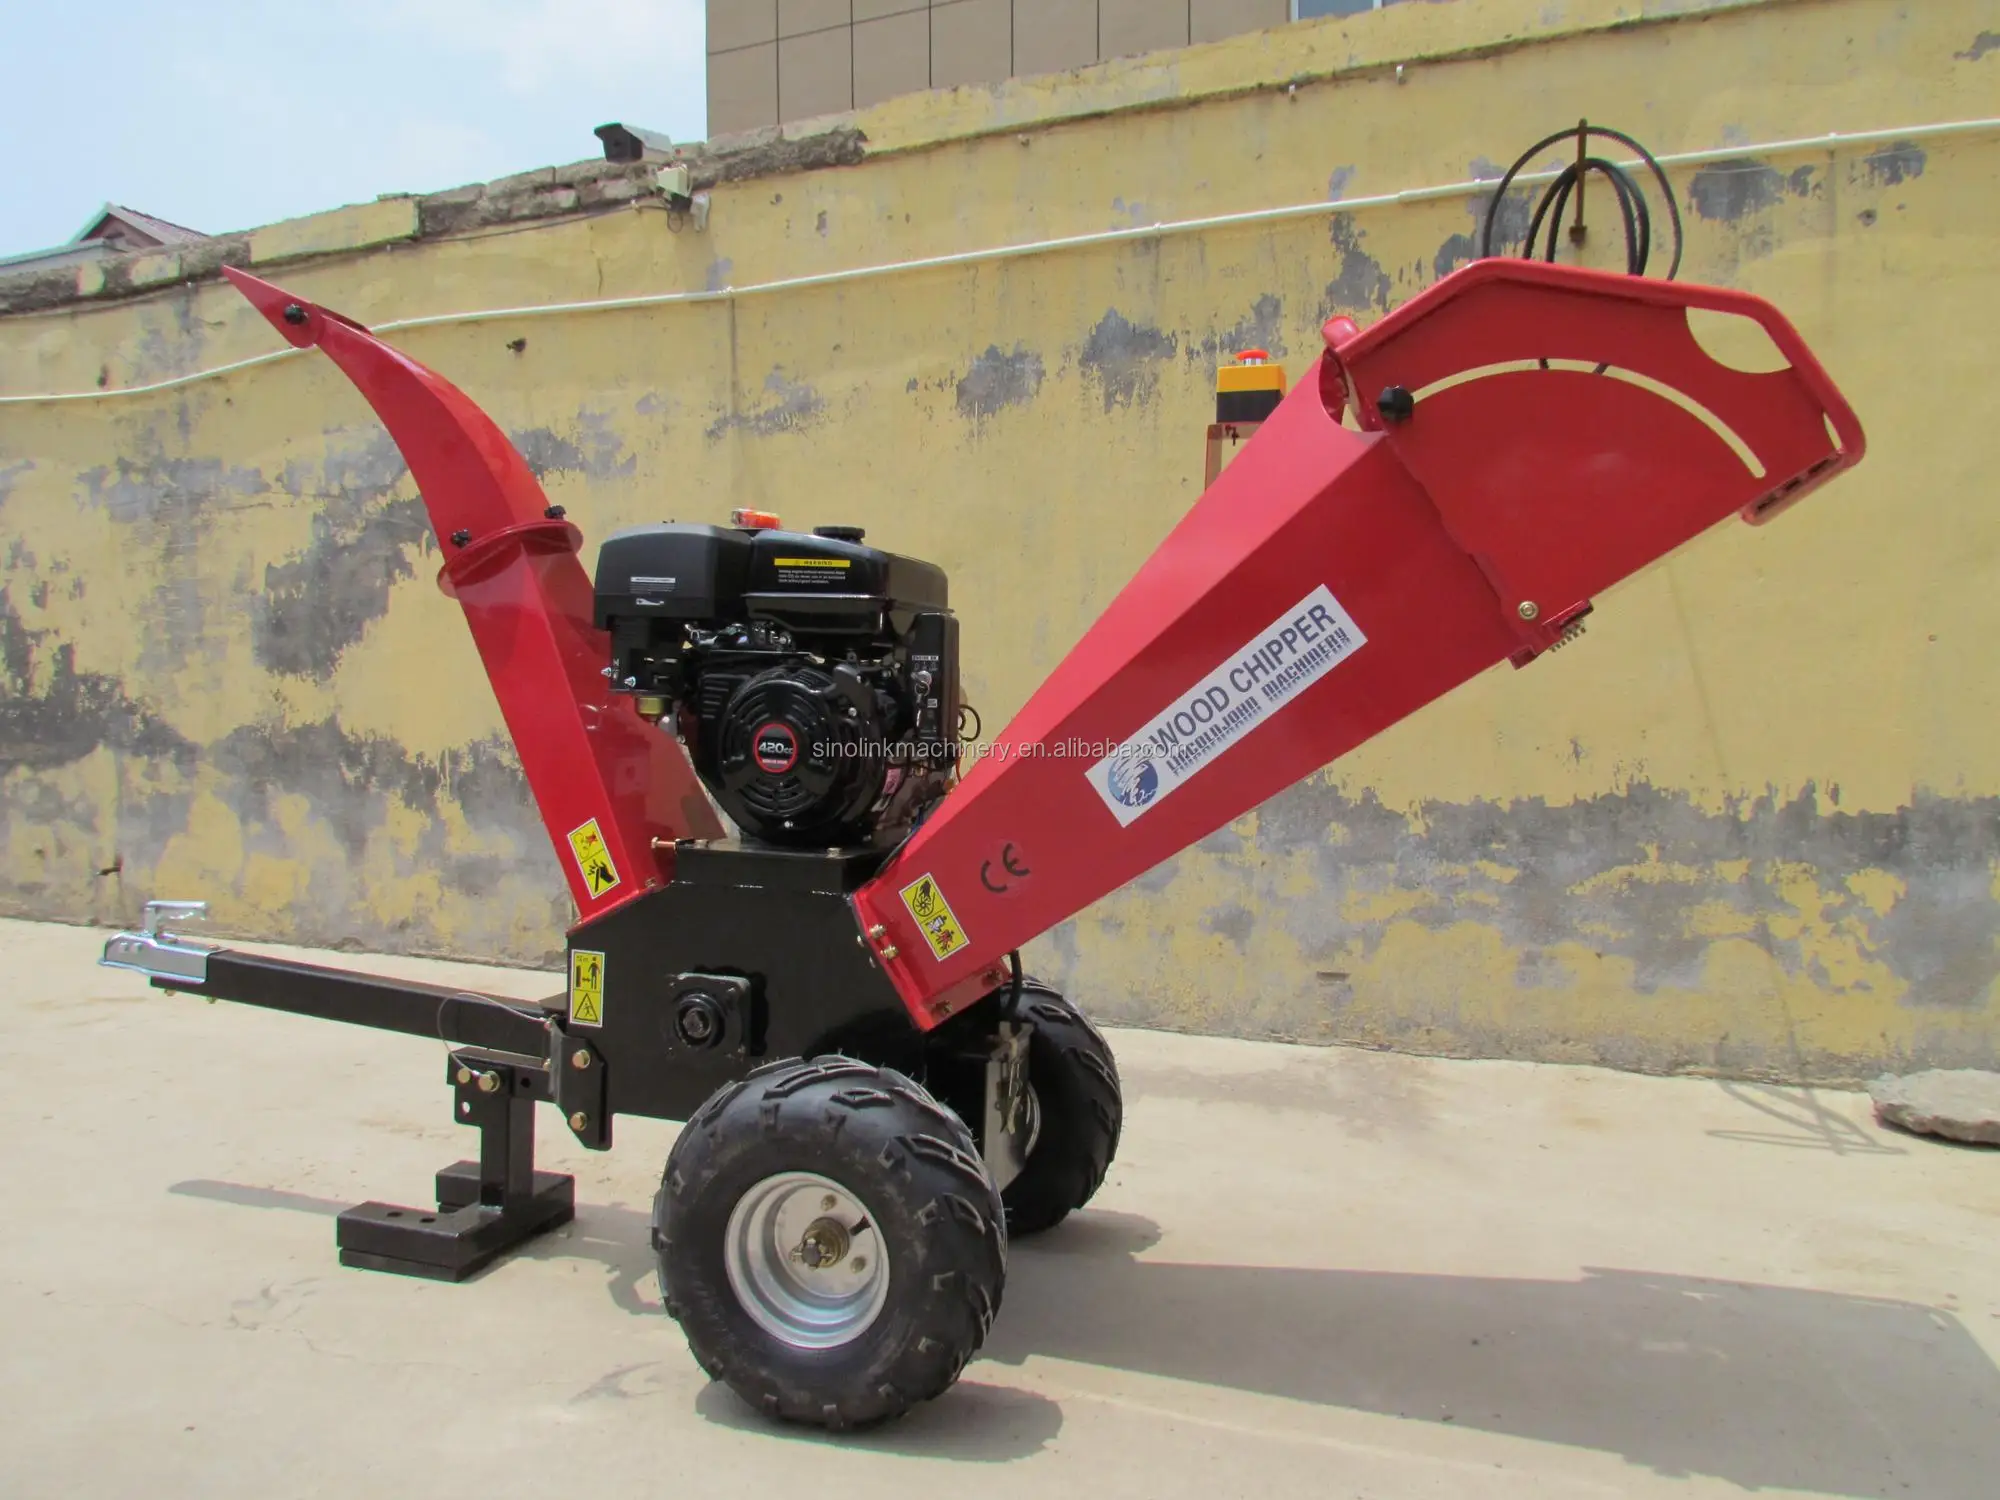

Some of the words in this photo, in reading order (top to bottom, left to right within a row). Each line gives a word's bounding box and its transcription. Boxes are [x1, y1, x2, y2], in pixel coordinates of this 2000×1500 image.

[1149, 685, 1230, 755] WOOD
[1229, 603, 1337, 693] CHIPPER
[758, 741, 794, 754] 420cc
